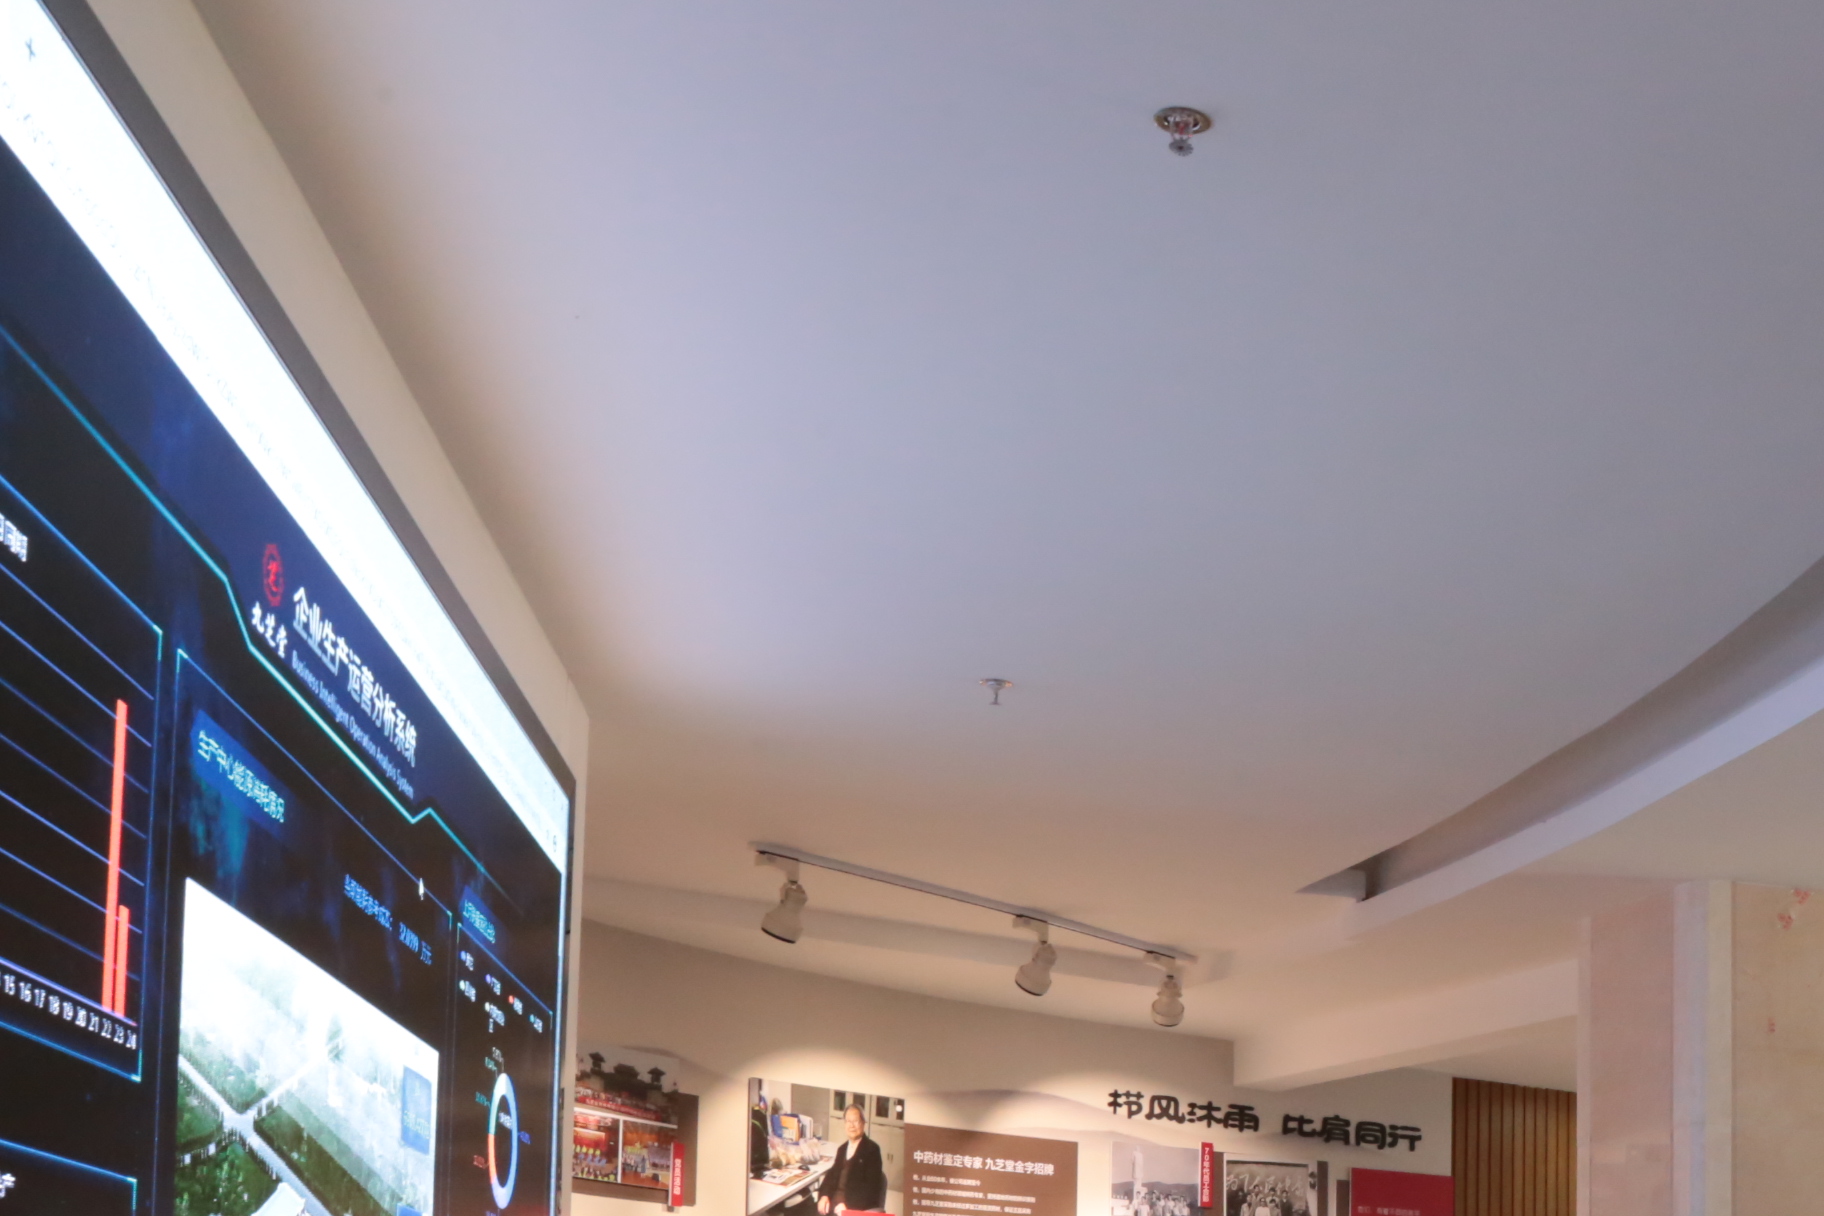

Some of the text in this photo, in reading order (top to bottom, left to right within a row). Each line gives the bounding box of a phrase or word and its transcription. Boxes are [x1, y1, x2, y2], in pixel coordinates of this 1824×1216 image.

[252, 601, 287, 659] 九芝堂
[293, 586, 417, 768] 企业生产运营分析系统
[4, 973, 137, 1051] 15 16 17 18 19 20 21 22 23 24
[1107, 1089, 1422, 1152] 栉风沐雨 比肩同行
[913, 1151, 1055, 1176] 中药材鉴定专家 九芝堂金字招牌
